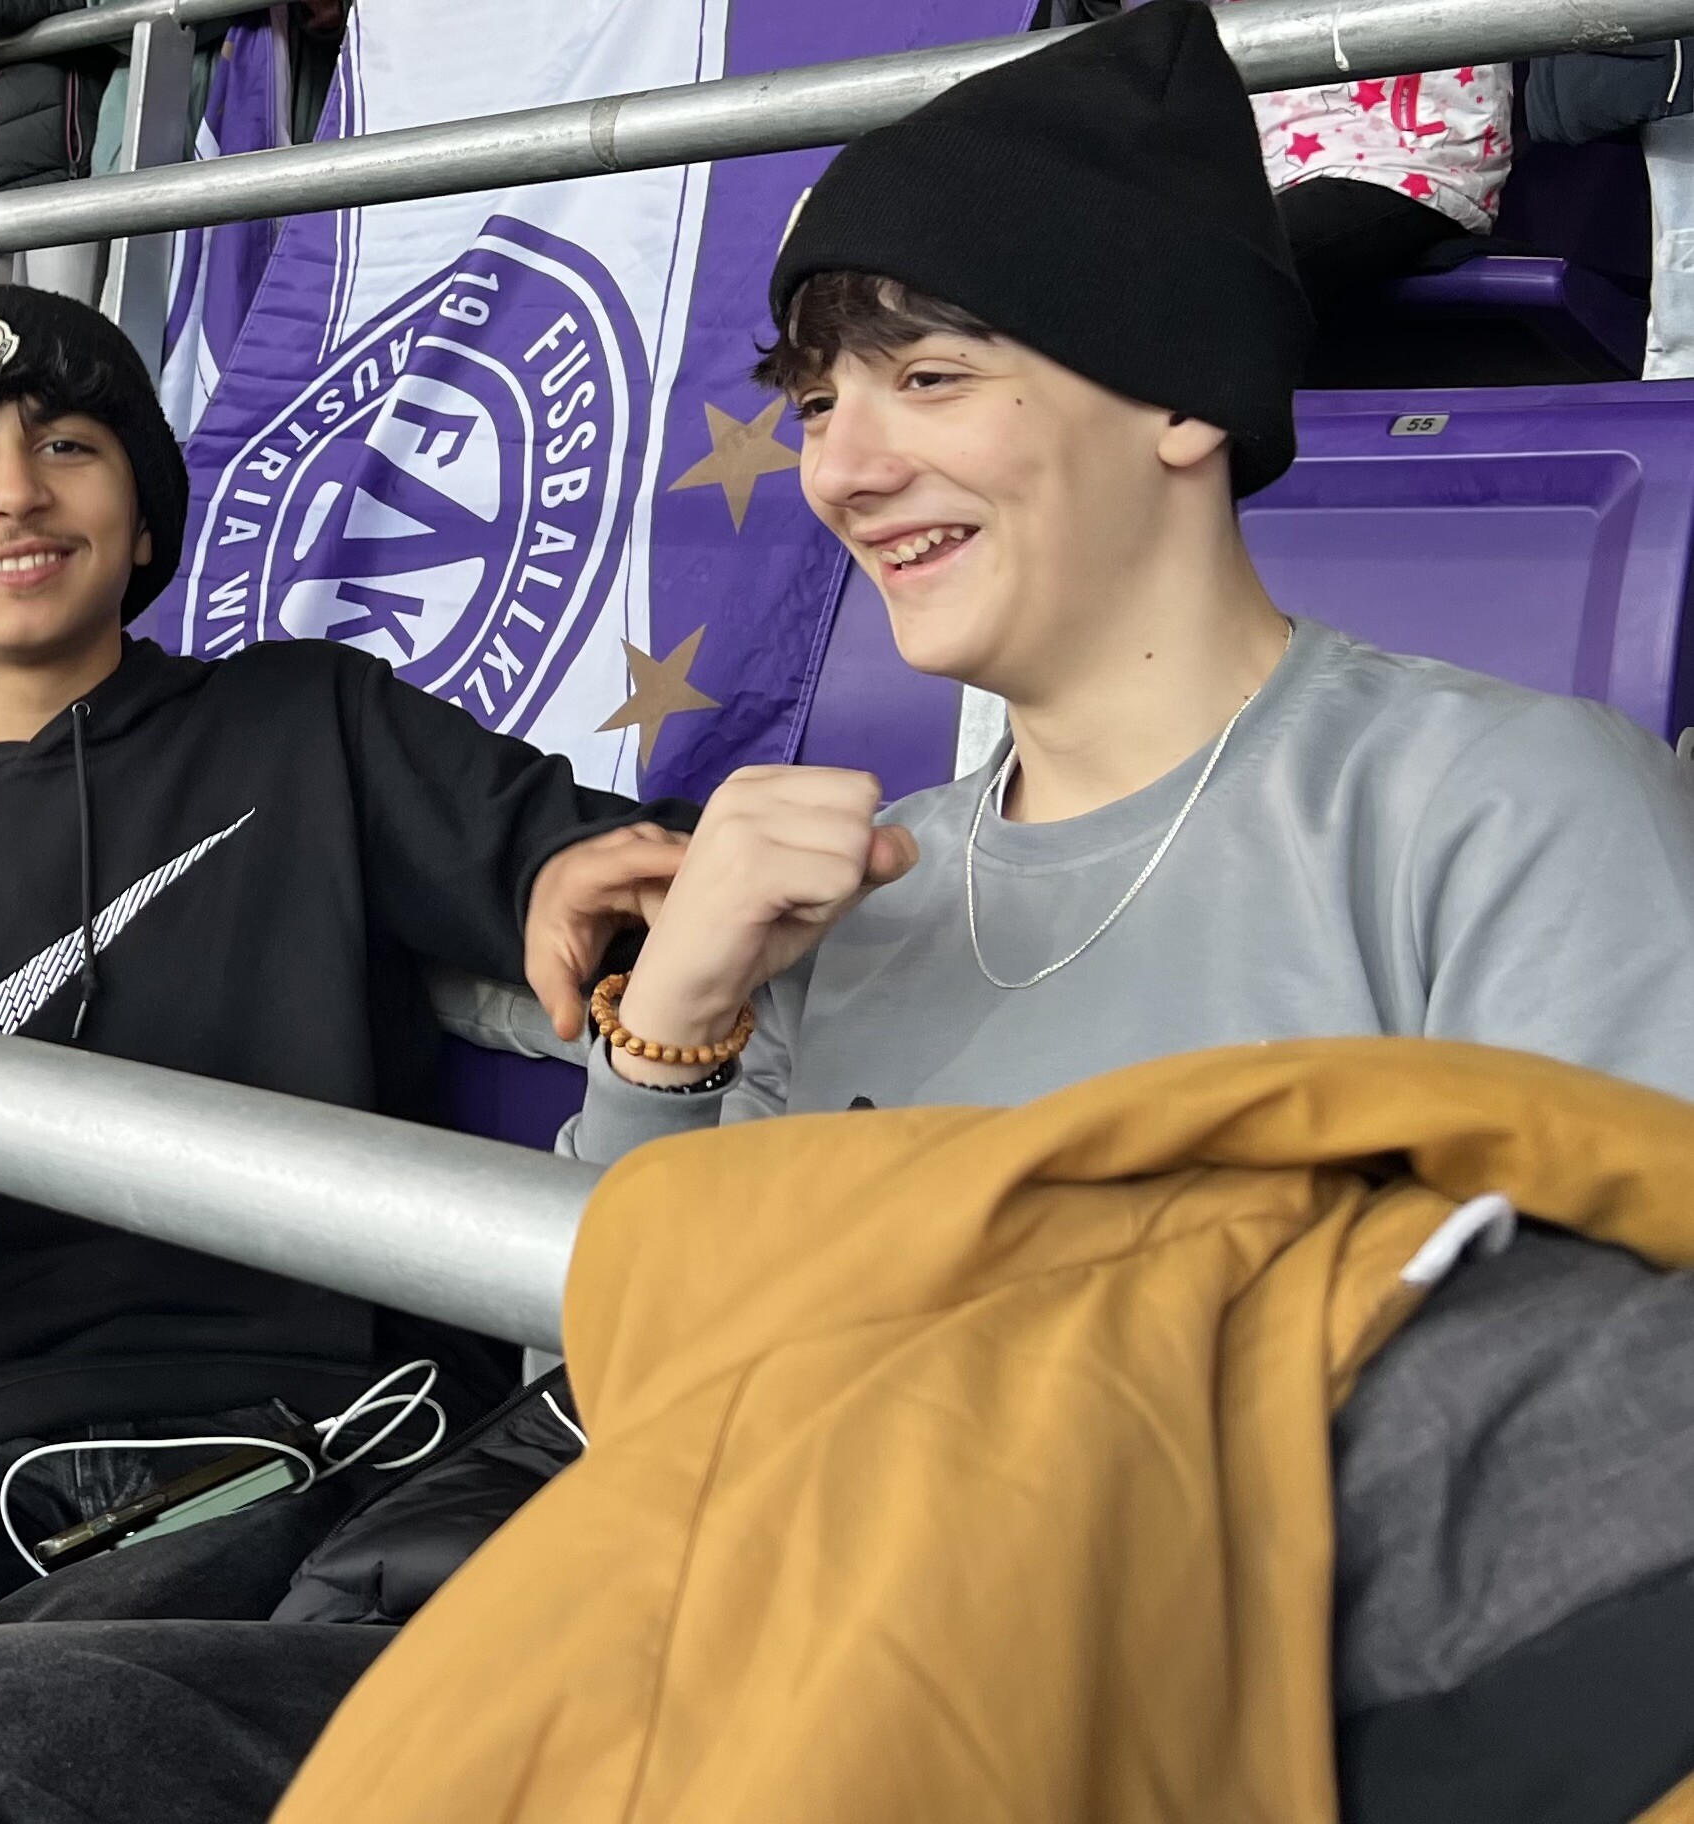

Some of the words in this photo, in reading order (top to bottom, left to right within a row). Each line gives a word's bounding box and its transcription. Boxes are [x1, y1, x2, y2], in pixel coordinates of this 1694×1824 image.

[438, 272, 499, 327] 19
[218, 326, 414, 546] AUSTRIA
[1406, 417, 1436, 431] 55
[448, 312, 597, 716] FUSSBALLKL
[204, 569, 251, 660] WI
